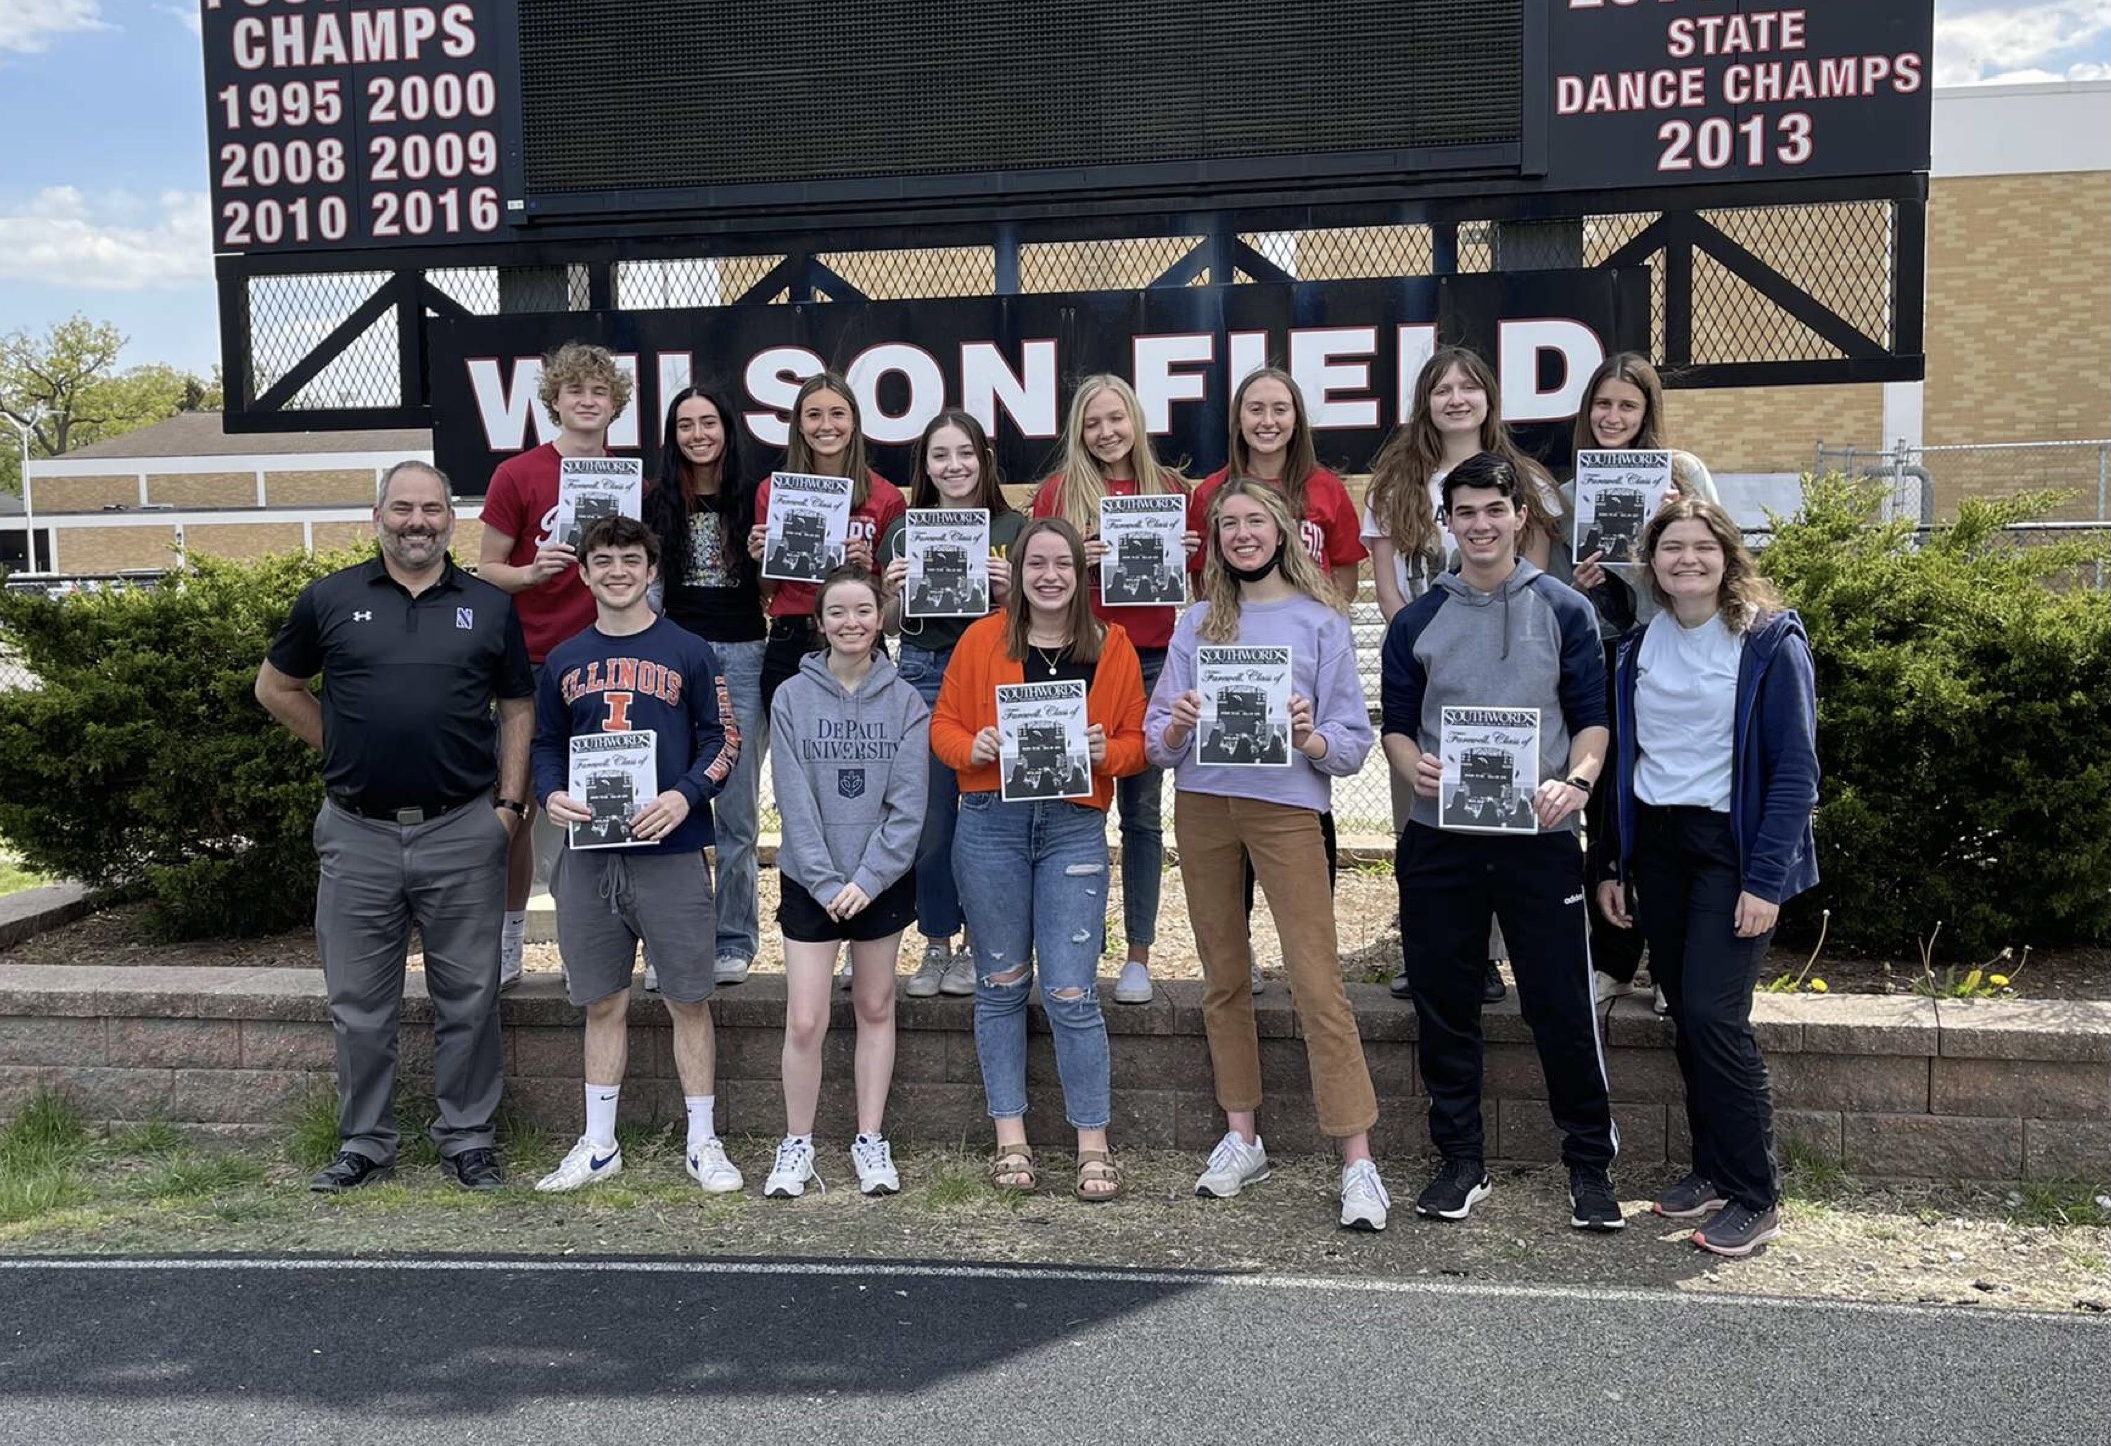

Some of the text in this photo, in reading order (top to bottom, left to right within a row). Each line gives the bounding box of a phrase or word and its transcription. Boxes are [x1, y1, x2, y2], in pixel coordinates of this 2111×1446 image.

[231, 3, 477, 70] CHAMPS
[1667, 9, 1807, 59] STATE
[218, 71, 496, 129] 1995 2000
[1556, 53, 1922, 115] DANCE CHAMPS
[220, 130, 498, 188] 2008 2009
[1656, 112, 1814, 172] 2013
[222, 186, 500, 245] 2010 2016
[1580, 452, 1667, 467] SOUTHWORDS
[908, 512, 986, 525] SOUTHWORDS
[1102, 497, 1183, 514] SOUTHWORDS
[1200, 649, 1287, 664] SOUTHWORDS
[561, 657, 682, 707] ILLINOIS
[999, 684, 1082, 703] SOUTHWORDS
[602, 692, 633, 732] I
[1444, 711, 1537, 728] SOUTHWORDS
[572, 734, 650, 753] SOUTHWORDS
[803, 739, 899, 760] UNIVERSITY
